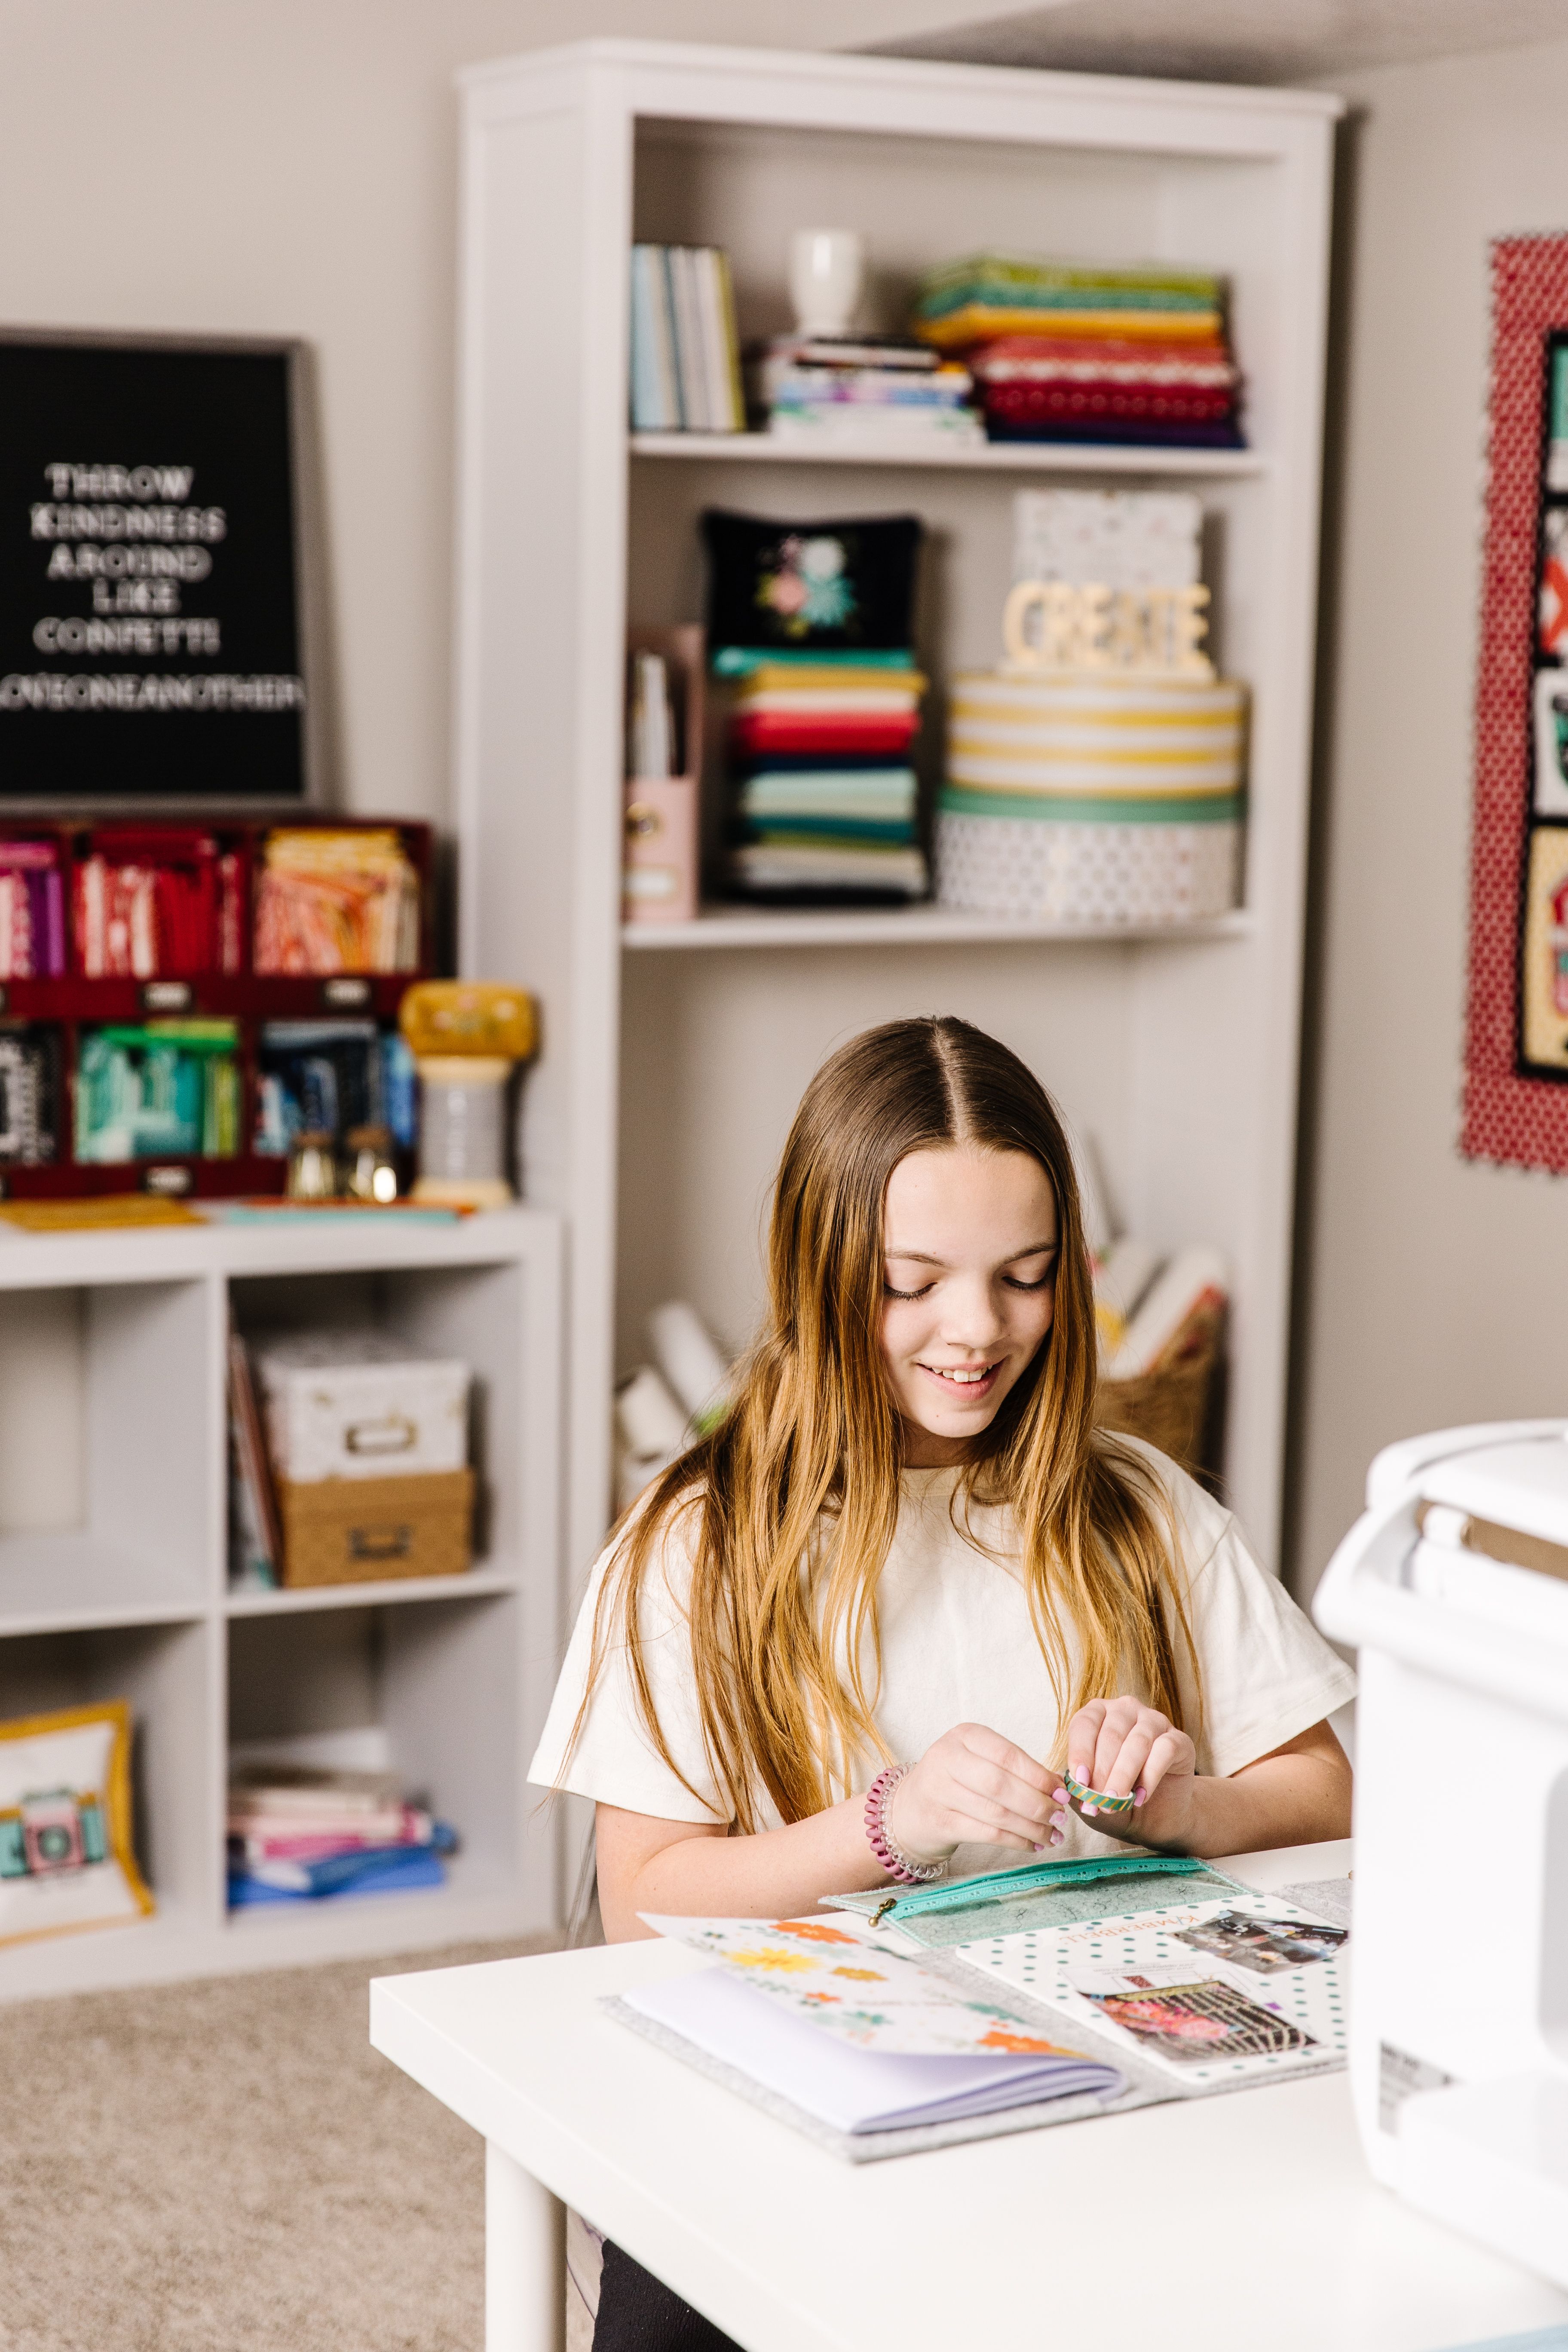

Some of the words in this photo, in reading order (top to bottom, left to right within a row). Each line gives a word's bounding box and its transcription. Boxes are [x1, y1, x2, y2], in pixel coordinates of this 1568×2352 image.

[45, 463, 194, 501] THROW
[30, 502, 227, 543] KINDNESS
[47, 543, 213, 582] AROUND
[93, 578, 180, 614] LIKE
[33, 617, 220, 655] CONFETTI
[1003, 579, 1211, 667] CREATE
[0, 673, 304, 711] OVEONEANOTHER
[1059, 1915, 1200, 1943] KIMBERBELL
